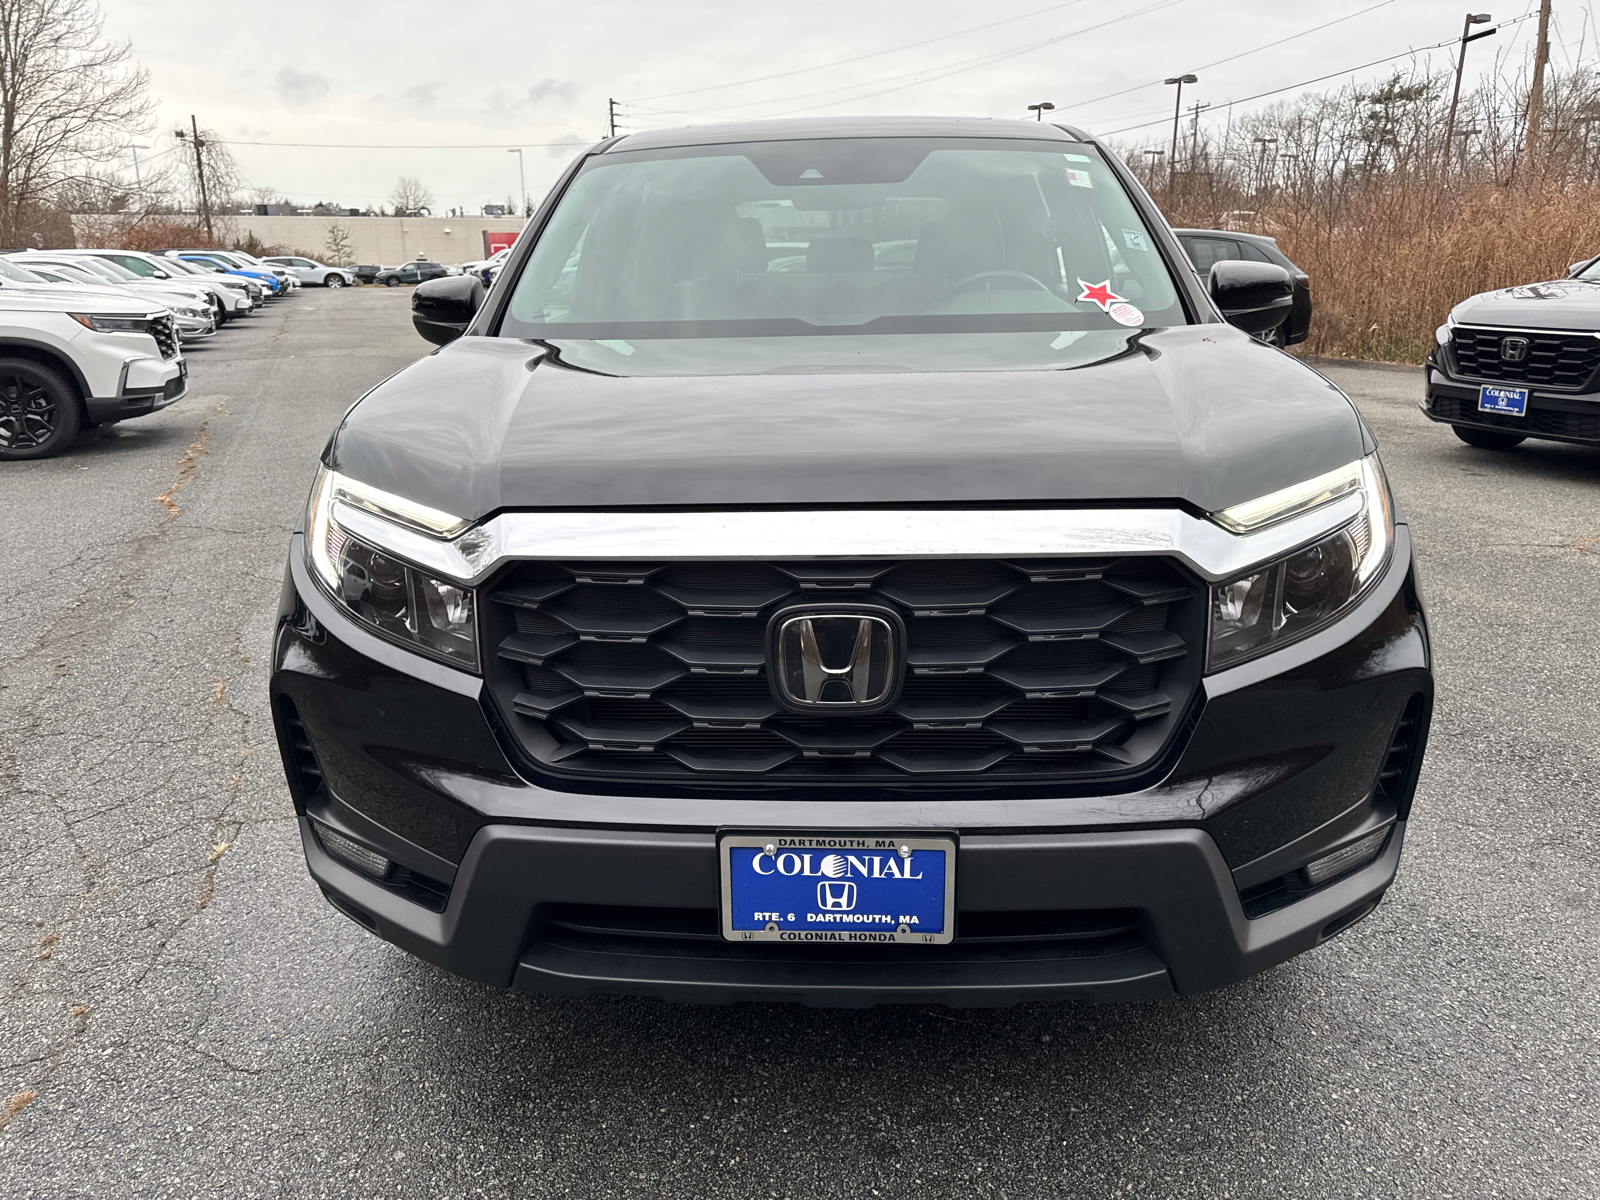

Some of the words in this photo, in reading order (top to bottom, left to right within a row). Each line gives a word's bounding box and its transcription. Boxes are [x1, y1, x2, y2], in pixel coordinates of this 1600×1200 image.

[1486, 389, 1521, 399] COLONIAL
[778, 838, 870, 848] DARTMOUTH,
[875, 839, 896, 848] MA
[752, 852, 923, 880] COLONIAL
[754, 912, 783, 922] RTE.
[787, 913, 796, 922] 6
[806, 913, 895, 925] DARTMOUTH,
[898, 914, 920, 924] MA
[779, 931, 846, 942] COLONIAL
[848, 933, 897, 943] HONDA
